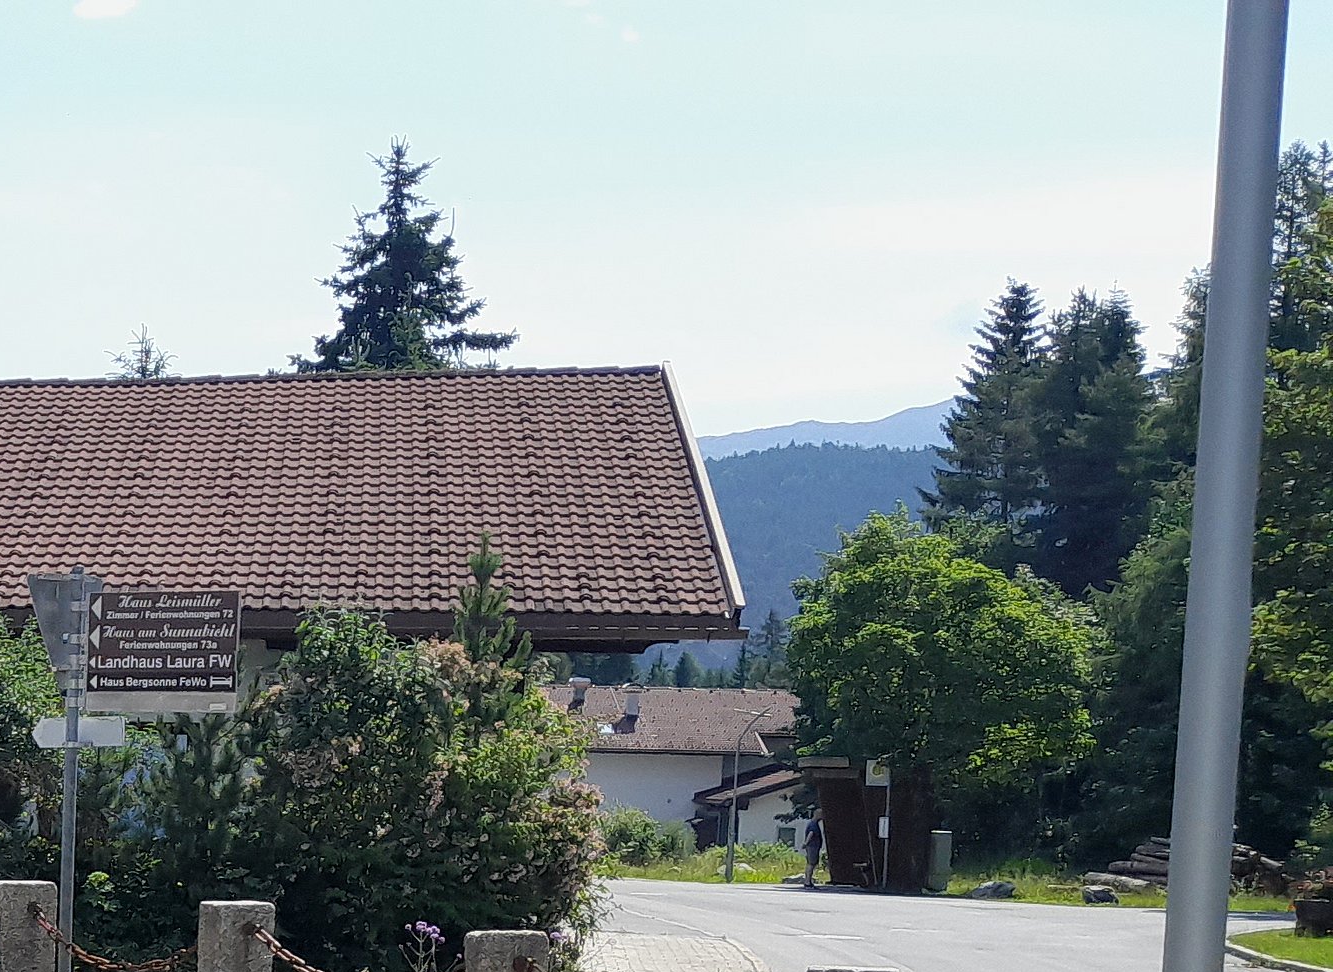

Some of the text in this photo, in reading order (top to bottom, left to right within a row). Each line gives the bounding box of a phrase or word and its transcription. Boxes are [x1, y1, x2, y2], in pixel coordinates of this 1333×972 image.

[118, 594, 222, 608] Haus Leismüller
[106, 611, 139, 619] Zimmer
[146, 611, 220, 619] Ferienwohnungen
[223, 610, 233, 618] 72
[103, 626, 134, 638] Haus
[138, 629, 156, 637] am
[119, 640, 217, 651] Ferienwohnungen 73a
[98, 654, 232, 668] Landhaus Laura FW
[100, 677, 206, 688] Haus Bergsonne FeWo
